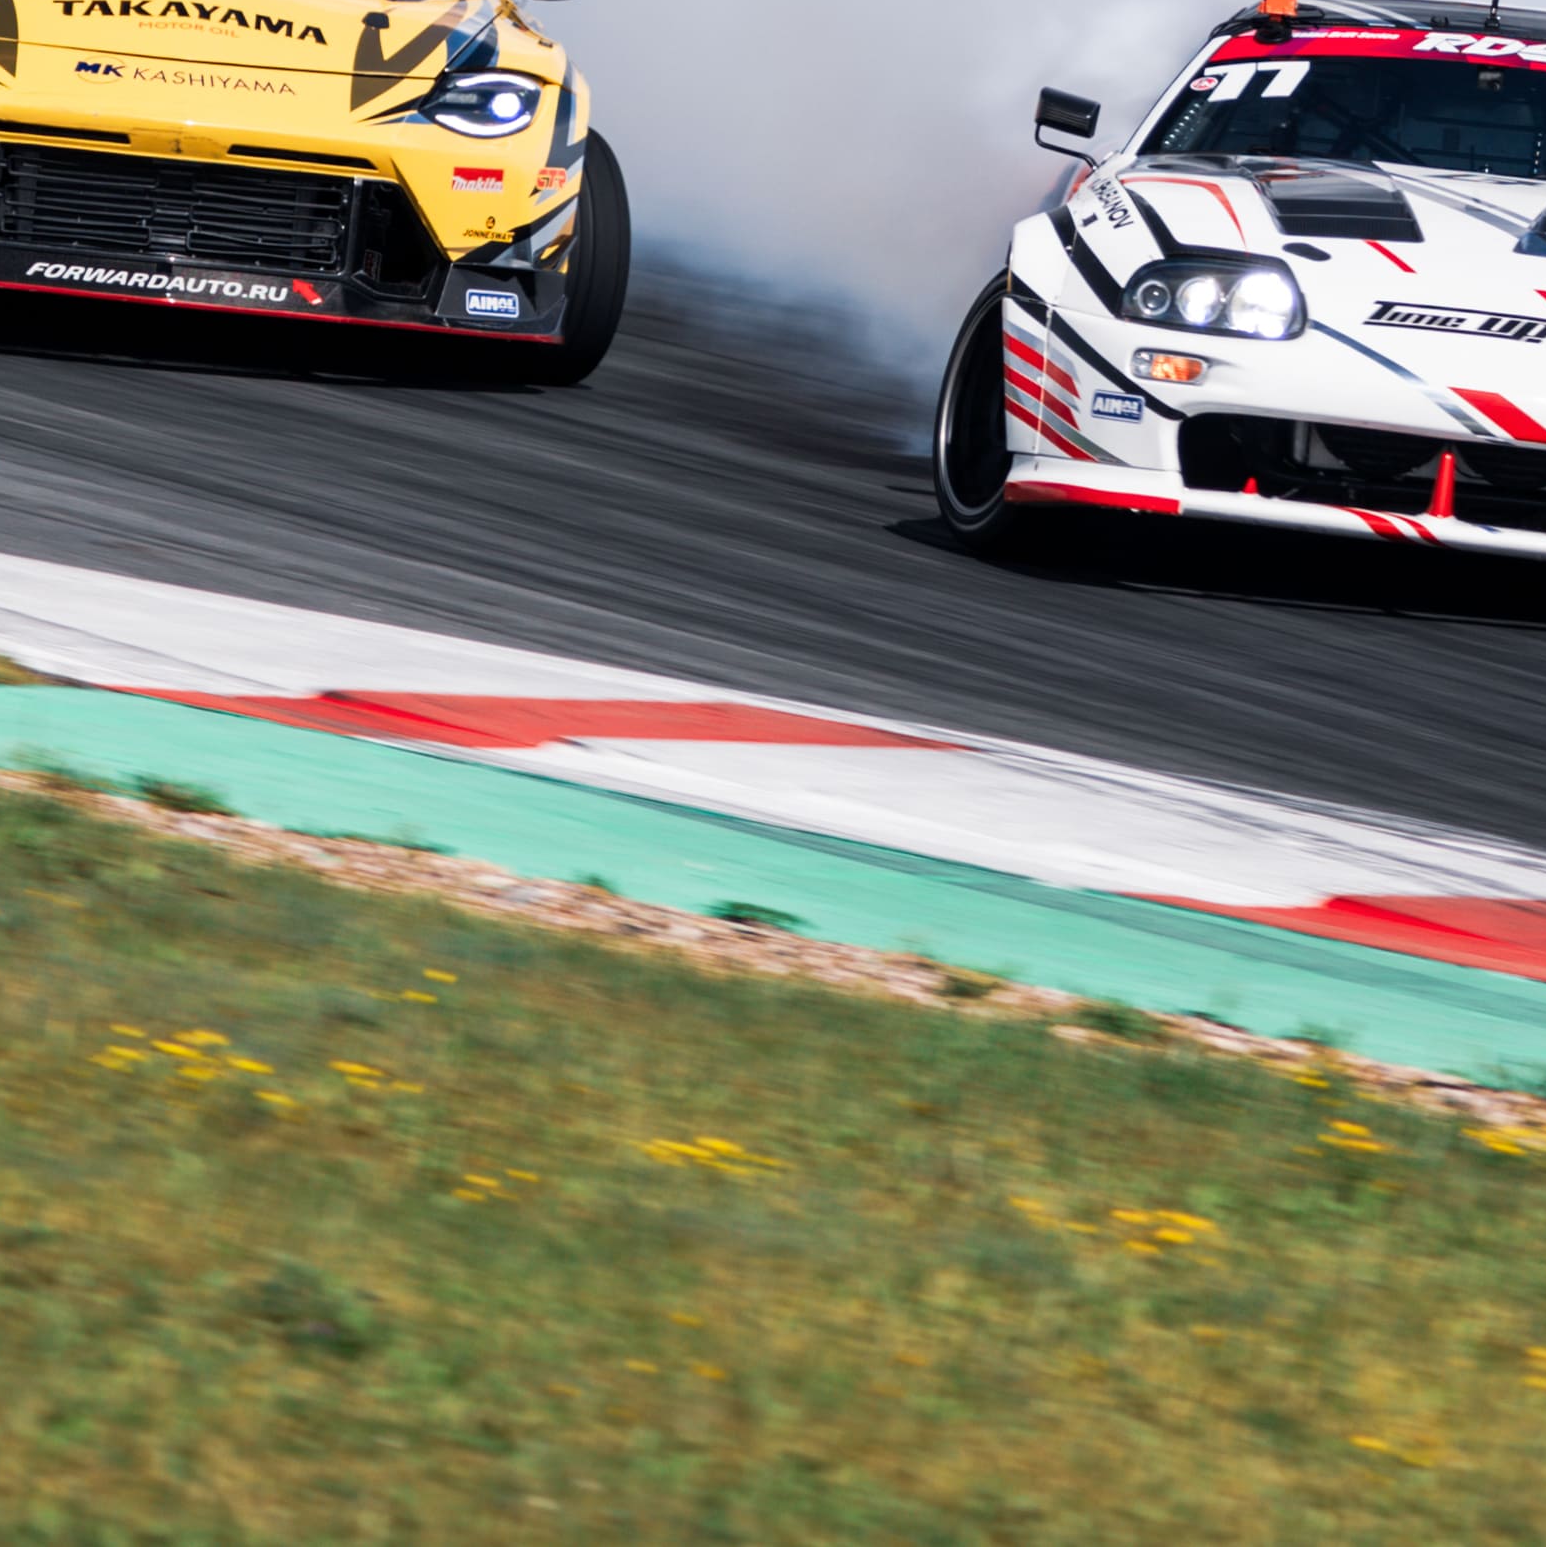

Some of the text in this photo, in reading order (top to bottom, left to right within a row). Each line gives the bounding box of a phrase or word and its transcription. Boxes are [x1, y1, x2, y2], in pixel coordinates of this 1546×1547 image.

[53, 0, 328, 45] TAKAYAMA
[138, 21, 240, 38] MOTOR OIL
[74, 61, 297, 96] MK KASHIYAMA
[25, 261, 289, 302] FORWARDAUTO.RU
